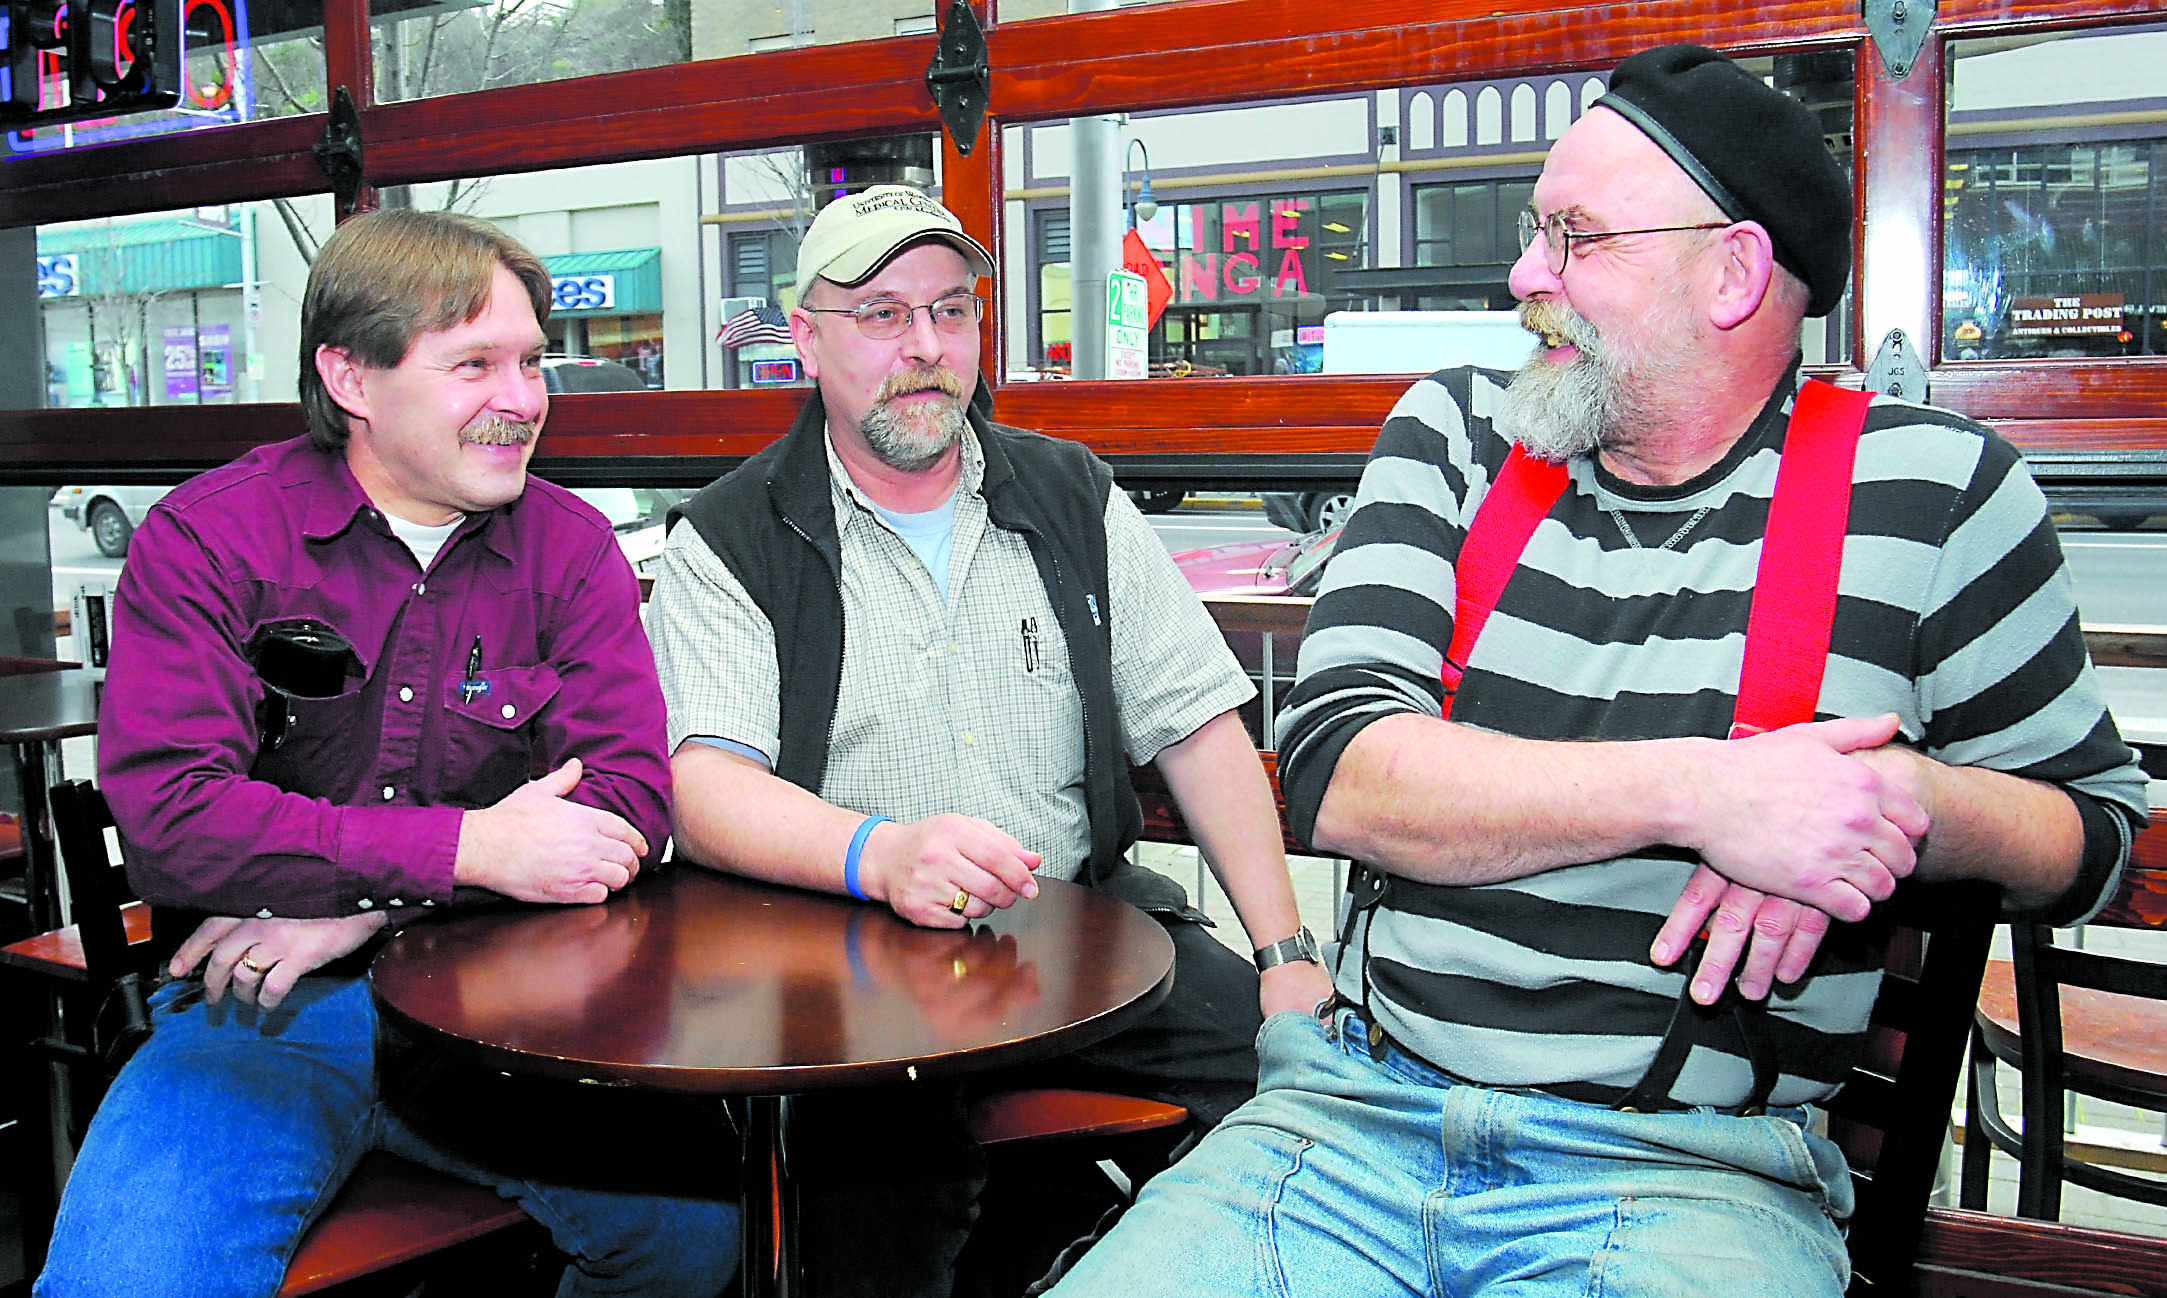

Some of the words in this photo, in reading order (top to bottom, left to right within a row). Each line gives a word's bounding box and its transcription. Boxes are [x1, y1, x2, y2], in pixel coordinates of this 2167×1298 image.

[855, 198, 907, 217] MEDICAL
[552, 277, 606, 309] es
[1110, 278, 1121, 321] 2
[2053, 297, 2081, 308] THE
[2012, 307, 2079, 321] TRADING
[2082, 306, 2123, 319] POST
[757, 364, 793, 380] OPEN
